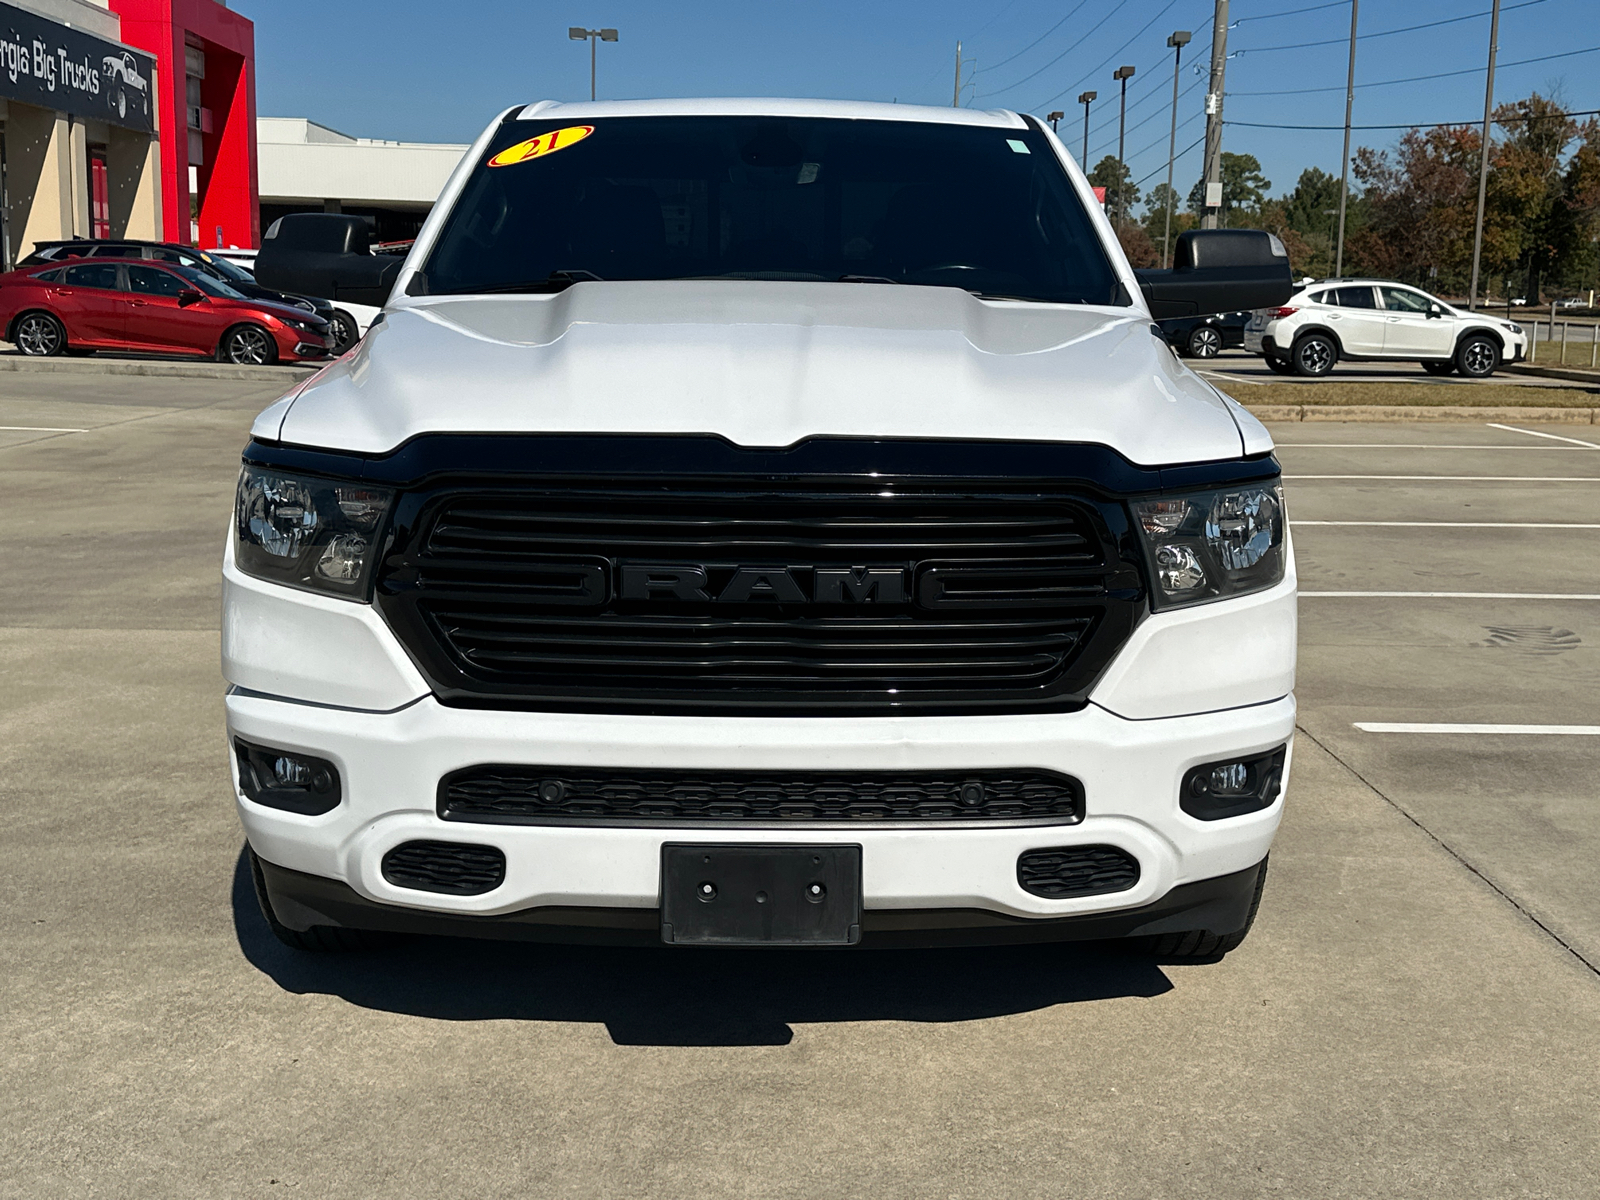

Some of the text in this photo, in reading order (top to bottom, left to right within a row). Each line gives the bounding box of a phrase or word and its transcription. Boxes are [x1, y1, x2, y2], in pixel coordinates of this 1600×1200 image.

[0, 34, 99, 94] rgia Big Trucks
[519, 131, 560, 160] 21
[620, 564, 905, 603] RAM
